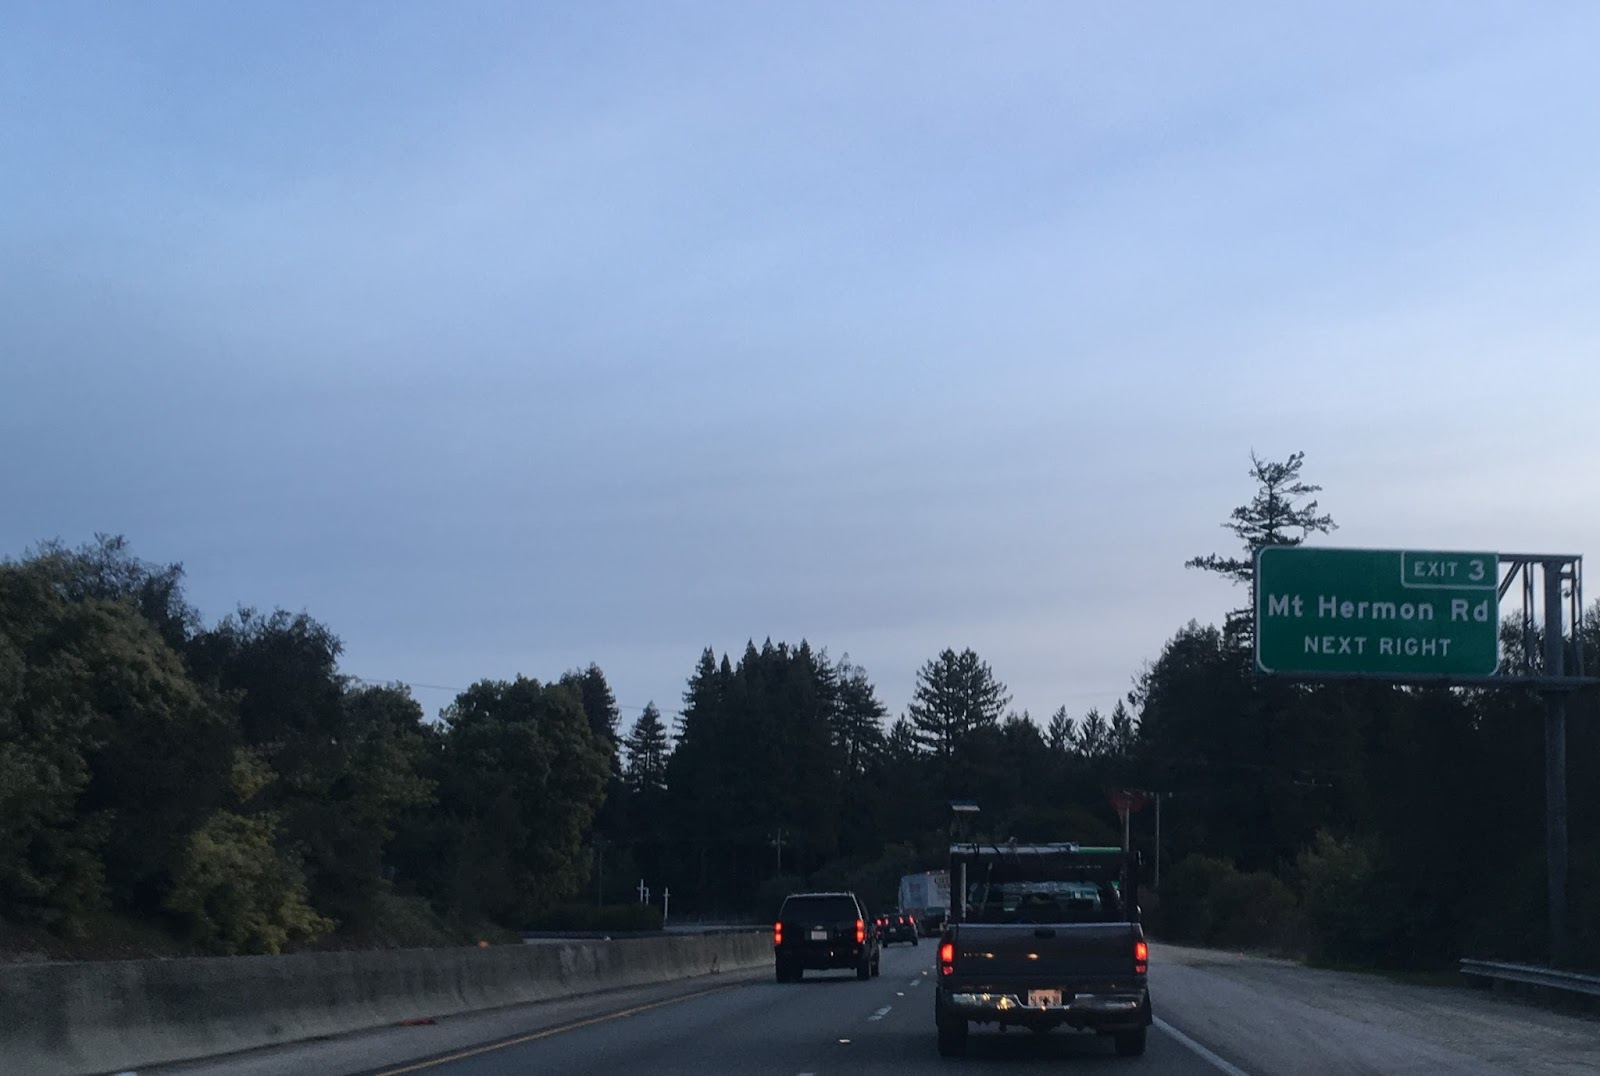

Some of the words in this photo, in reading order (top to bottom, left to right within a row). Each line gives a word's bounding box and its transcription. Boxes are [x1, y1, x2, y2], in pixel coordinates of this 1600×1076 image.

[1414, 561, 1458, 577] EXIT
[1468, 559, 1485, 581] 3
[1268, 593, 1304, 617] Mt
[1318, 595, 1434, 620] Hermon
[1450, 598, 1488, 622] Rd
[1304, 635, 1367, 655] NEXT
[1379, 637, 1451, 656] RIGHT
